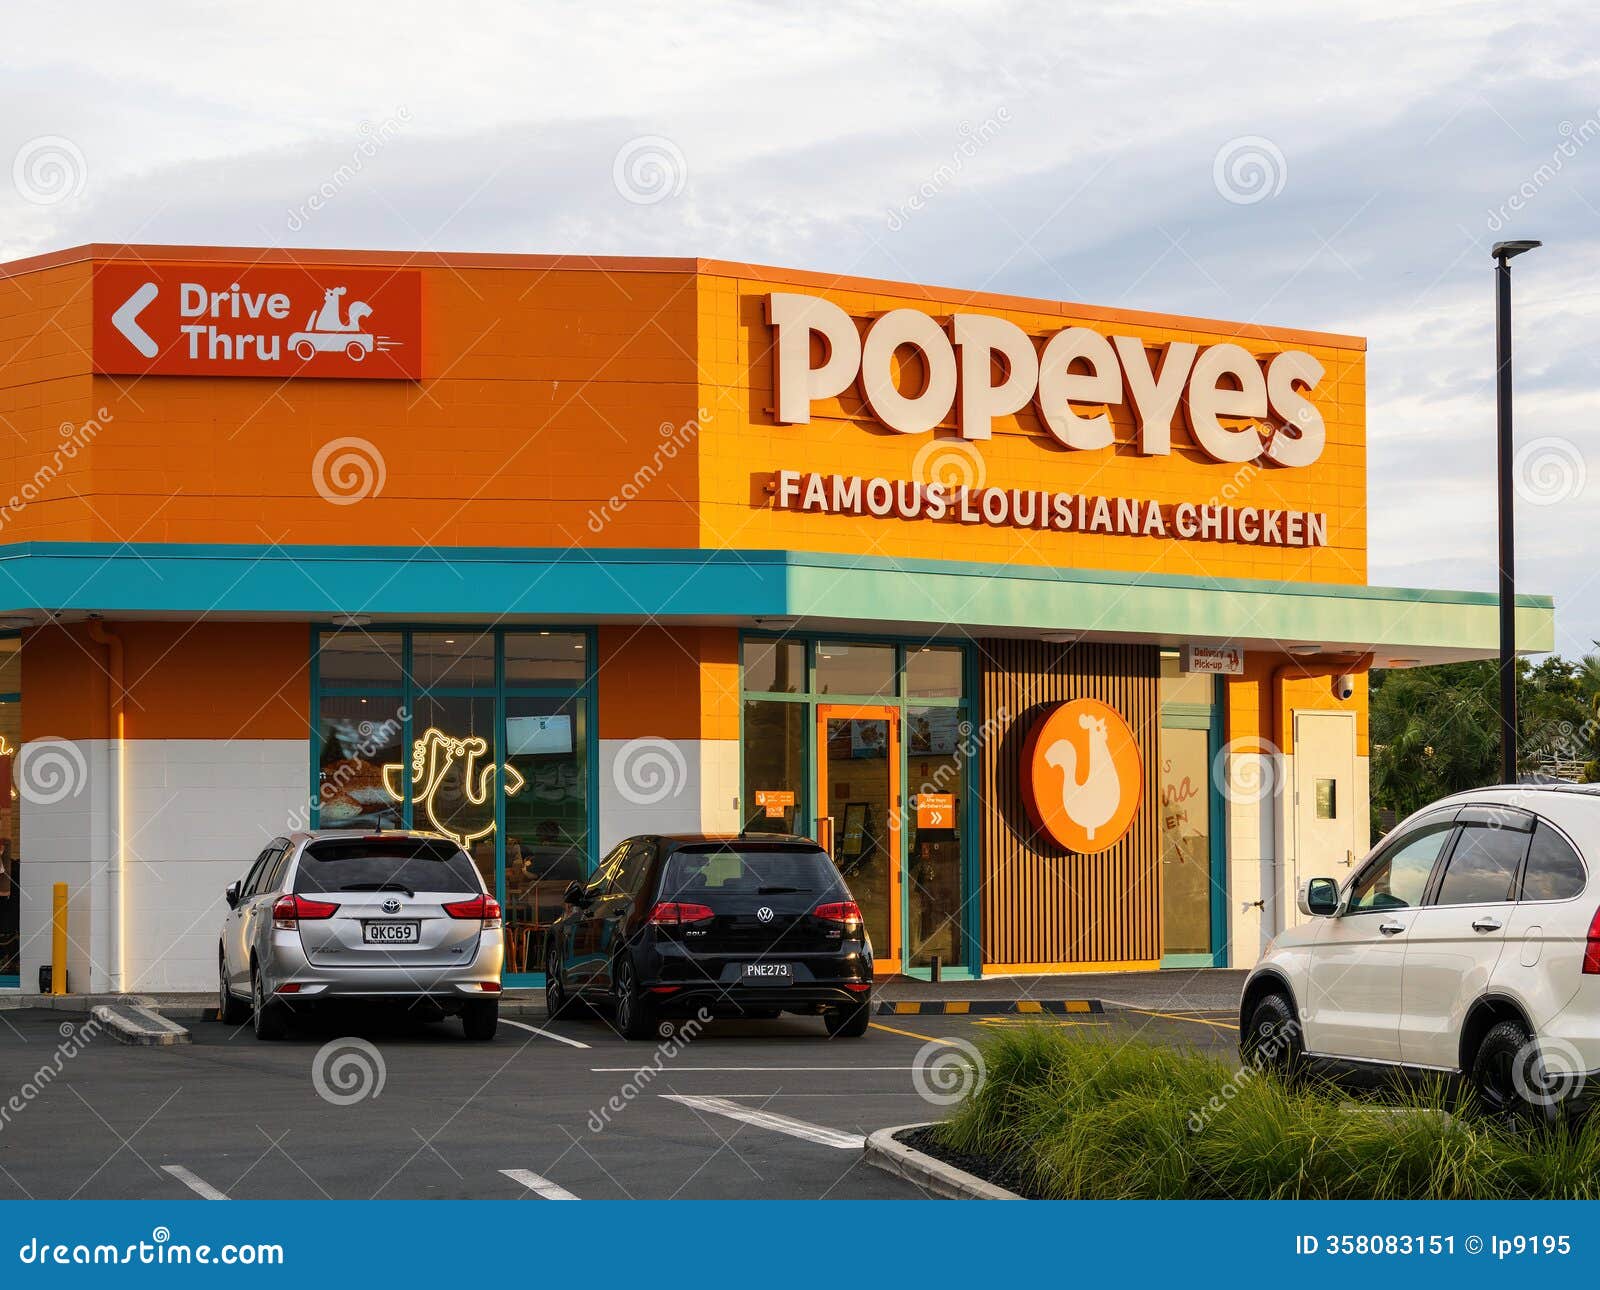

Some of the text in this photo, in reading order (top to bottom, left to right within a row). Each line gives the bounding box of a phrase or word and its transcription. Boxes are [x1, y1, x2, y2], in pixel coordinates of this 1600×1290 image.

[180, 282, 290, 319] Drive
[180, 325, 280, 361] Thru
[779, 470, 1328, 547] FAMOUS LOUISIANA CHICKEN
[1194, 647, 1224, 659] Delivery
[1194, 659, 1222, 671] Pick-up
[371, 926, 411, 939] QKC69
[747, 965, 787, 976] PNE273
